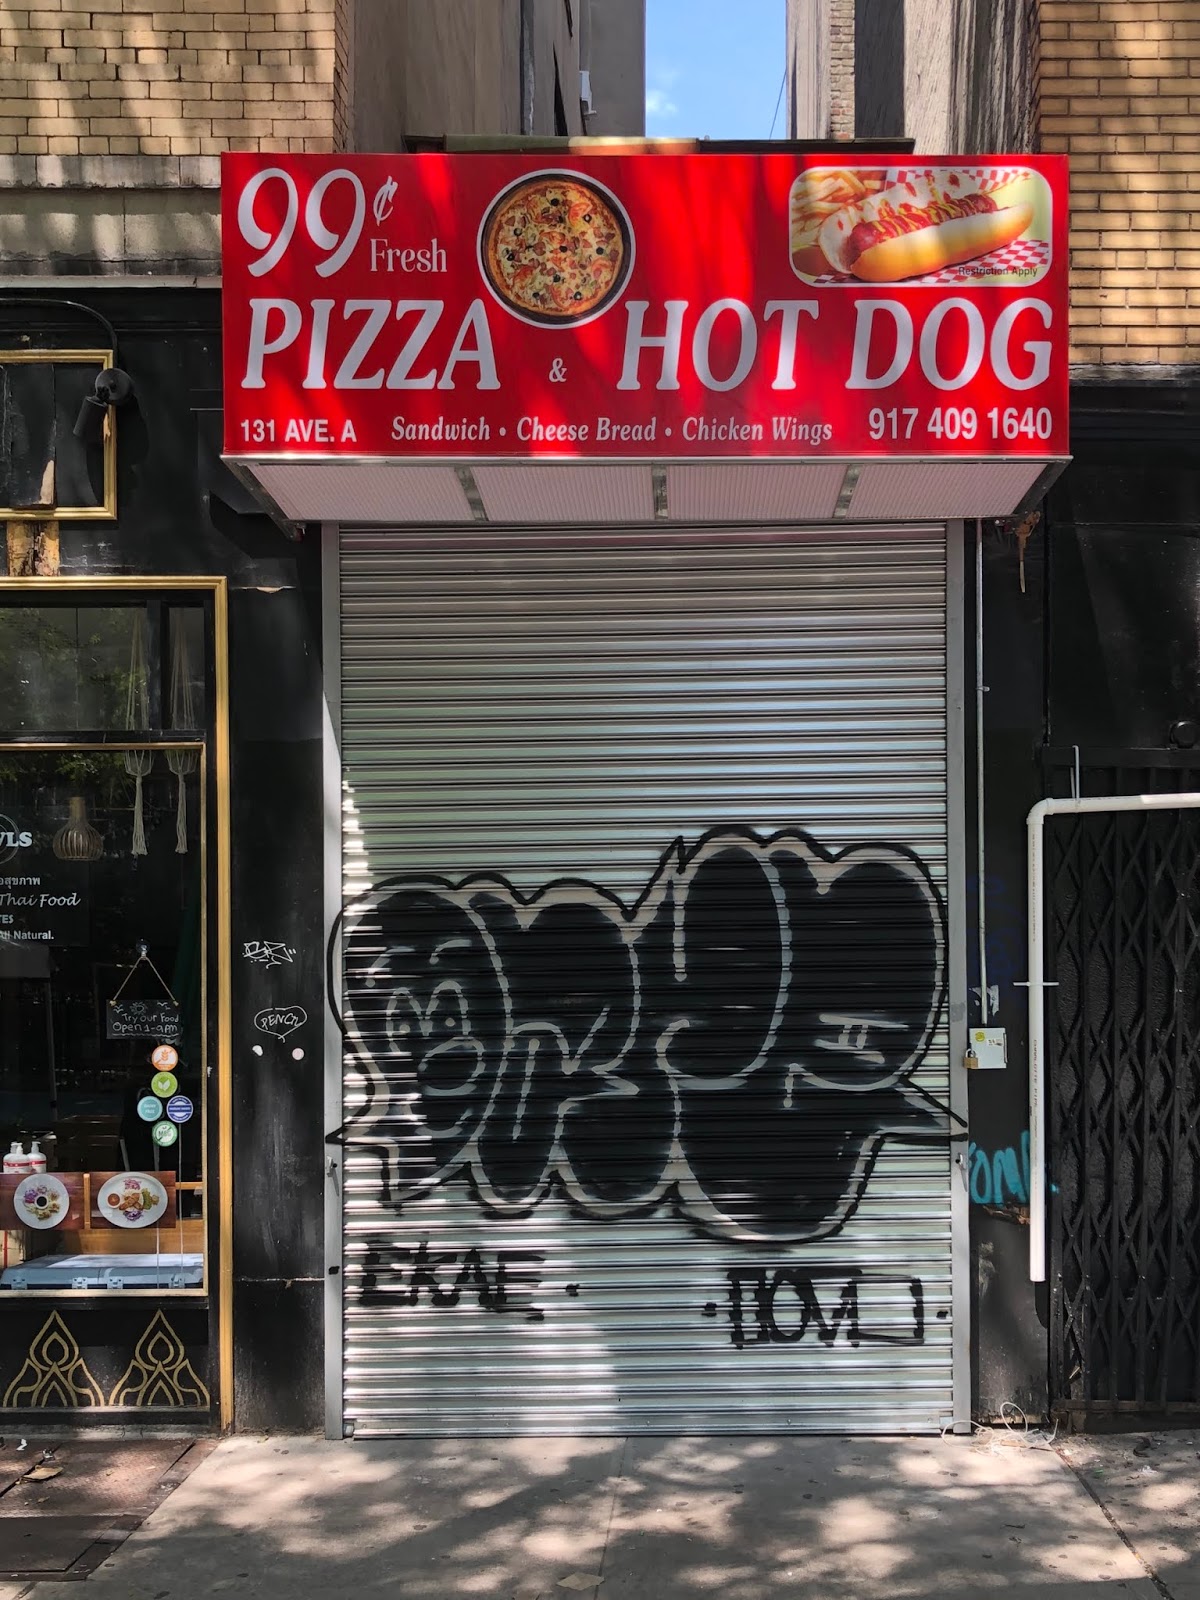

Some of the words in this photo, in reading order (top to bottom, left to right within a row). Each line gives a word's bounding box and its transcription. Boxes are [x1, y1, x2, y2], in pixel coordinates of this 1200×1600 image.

[370, 238, 447, 273] Fresh
[959, 267, 1009, 276] Restriction
[1012, 266, 1038, 278] Apply
[241, 298, 501, 390] PIZZA
[548, 357, 568, 383] &
[615, 297, 819, 391] HOT
[845, 297, 1053, 391] DOG
[241, 419, 276, 443] 131
[285, 419, 336, 443] AVE.
[340, 420, 358, 443] A
[391, 416, 491, 441] Sandwich
[516, 416, 589, 441] Cheese
[596, 416, 657, 441] Bread
[682, 416, 763, 441] Chicken
[772, 416, 833, 446] Wings
[868, 407, 919, 440] 917
[927, 407, 978, 440] 409
[987, 407, 1052, 440] 1640
[39, 891, 82, 907] Food
[13, 929, 55, 941] Natural.
[112, 1021, 143, 1034] Open
[121, 1012, 138, 1024] Try
[160, 1012, 179, 1023] Food
